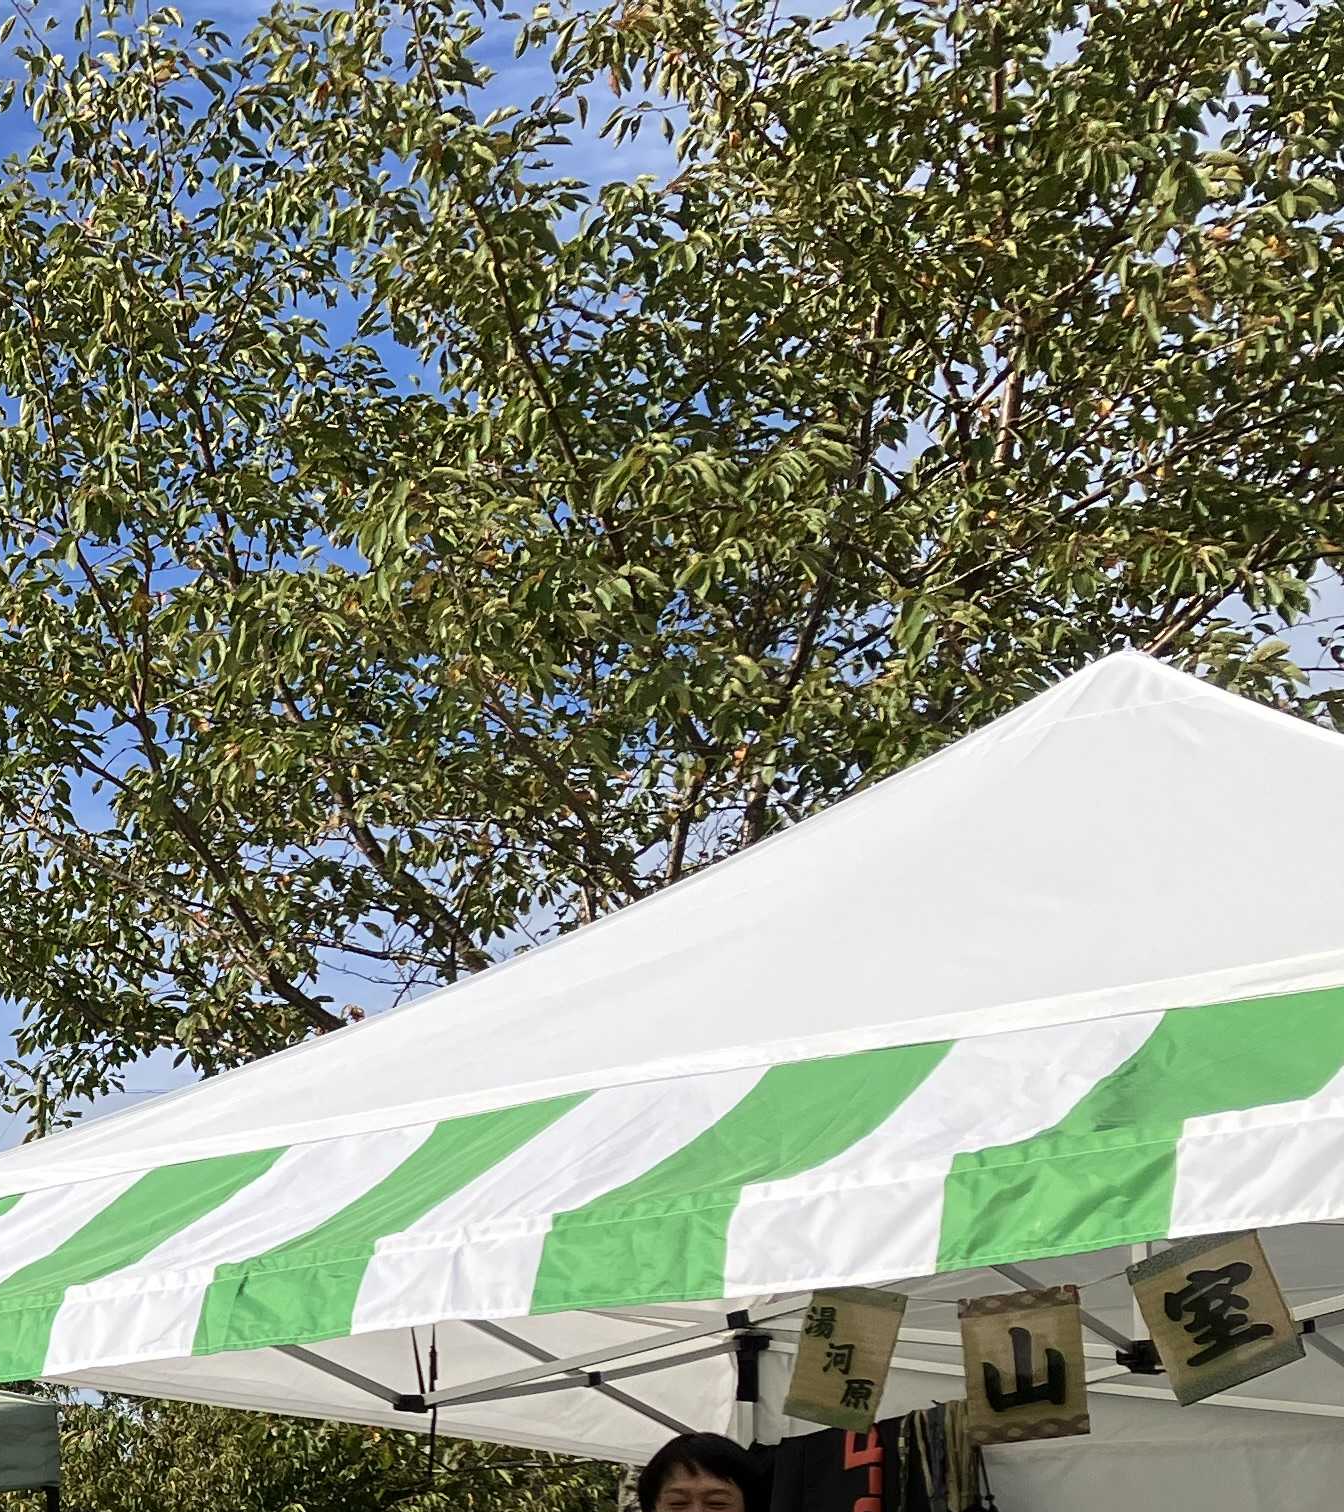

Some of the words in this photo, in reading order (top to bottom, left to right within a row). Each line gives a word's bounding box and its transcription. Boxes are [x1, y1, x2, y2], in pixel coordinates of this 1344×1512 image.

[804, 1305, 875, 1411] 湯河原
[982, 1327, 1066, 1413] 山
